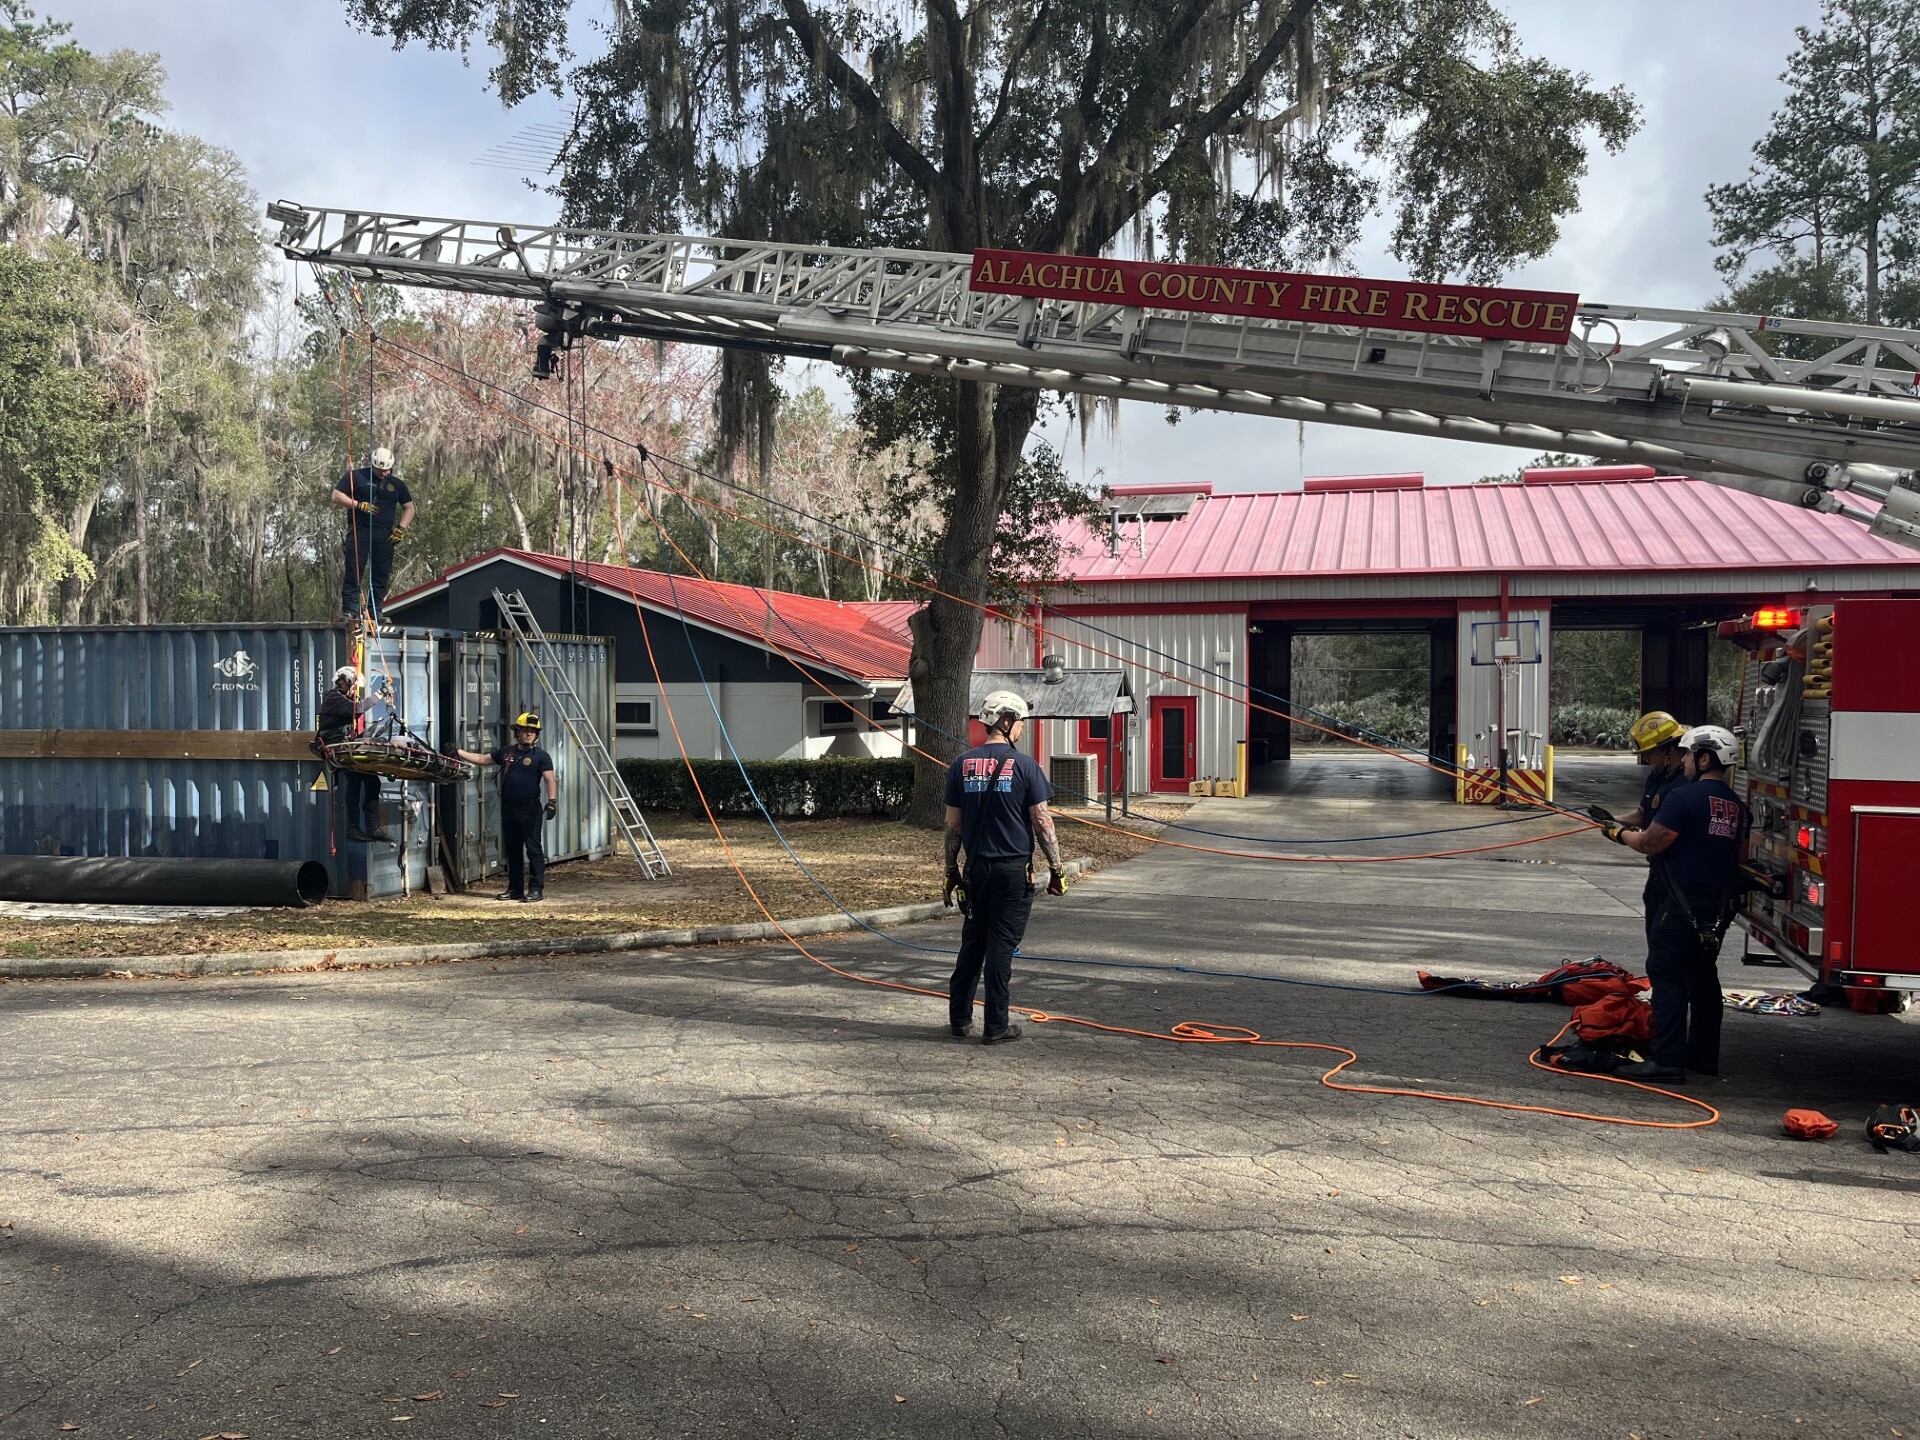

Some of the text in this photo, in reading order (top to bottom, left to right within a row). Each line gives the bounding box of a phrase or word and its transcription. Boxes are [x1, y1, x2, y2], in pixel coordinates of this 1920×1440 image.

[975, 259, 1570, 332] ALACHUA COUNTY FIRE RESCUE
[1766, 319, 1781, 328] 45
[212, 683, 260, 691] CRONOS
[963, 758, 1014, 776] FIRE
[1467, 786, 1484, 800] 16
